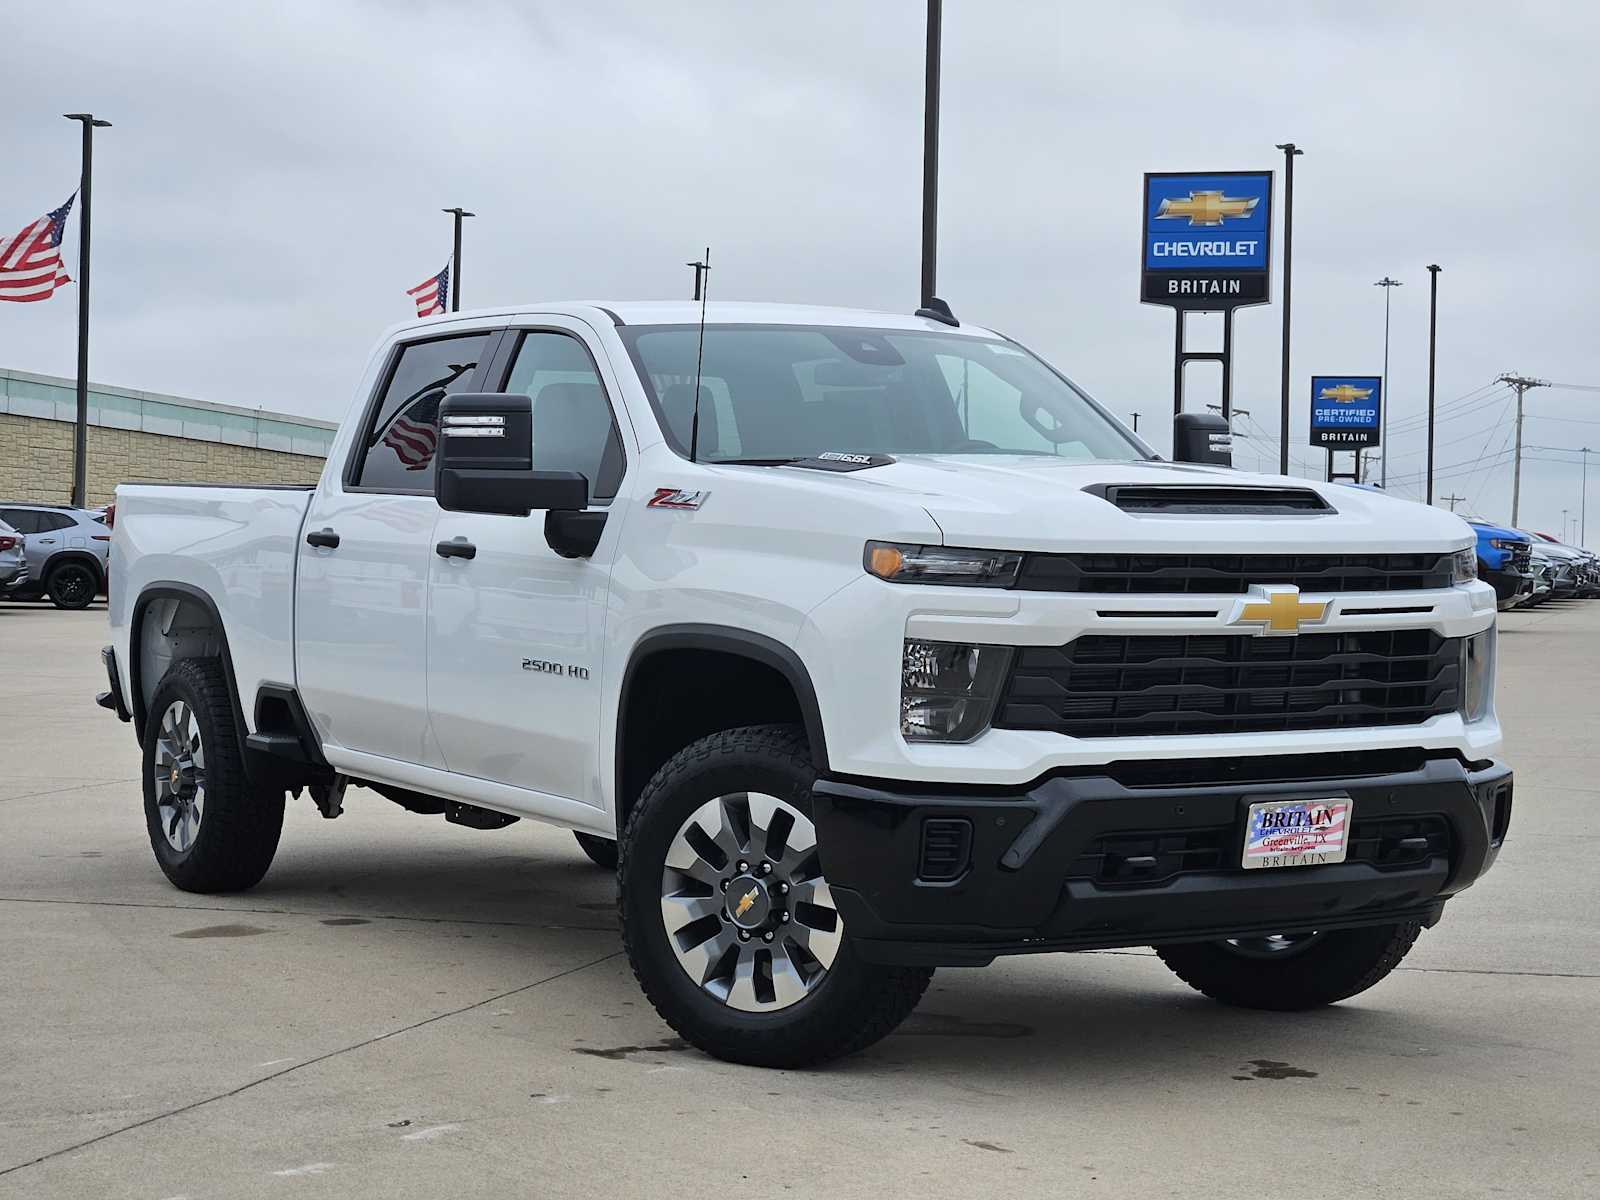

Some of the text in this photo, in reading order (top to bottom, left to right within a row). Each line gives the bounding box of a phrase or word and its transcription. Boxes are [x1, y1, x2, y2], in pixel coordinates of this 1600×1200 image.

[1153, 241, 1258, 256] CHEVROLET
[1168, 280, 1240, 293] BRITAIN
[1315, 408, 1376, 416] CERTIFIED
[1321, 433, 1368, 441] BRITAIN
[647, 488, 712, 511] Z71
[522, 658, 590, 681] 2500 HD
[1261, 809, 1336, 828] BRITAIN
[1260, 827, 1312, 836] CHEVROLET
[1262, 834, 1328, 847] Greenville, TX
[1262, 853, 1328, 867] BRITAIN
